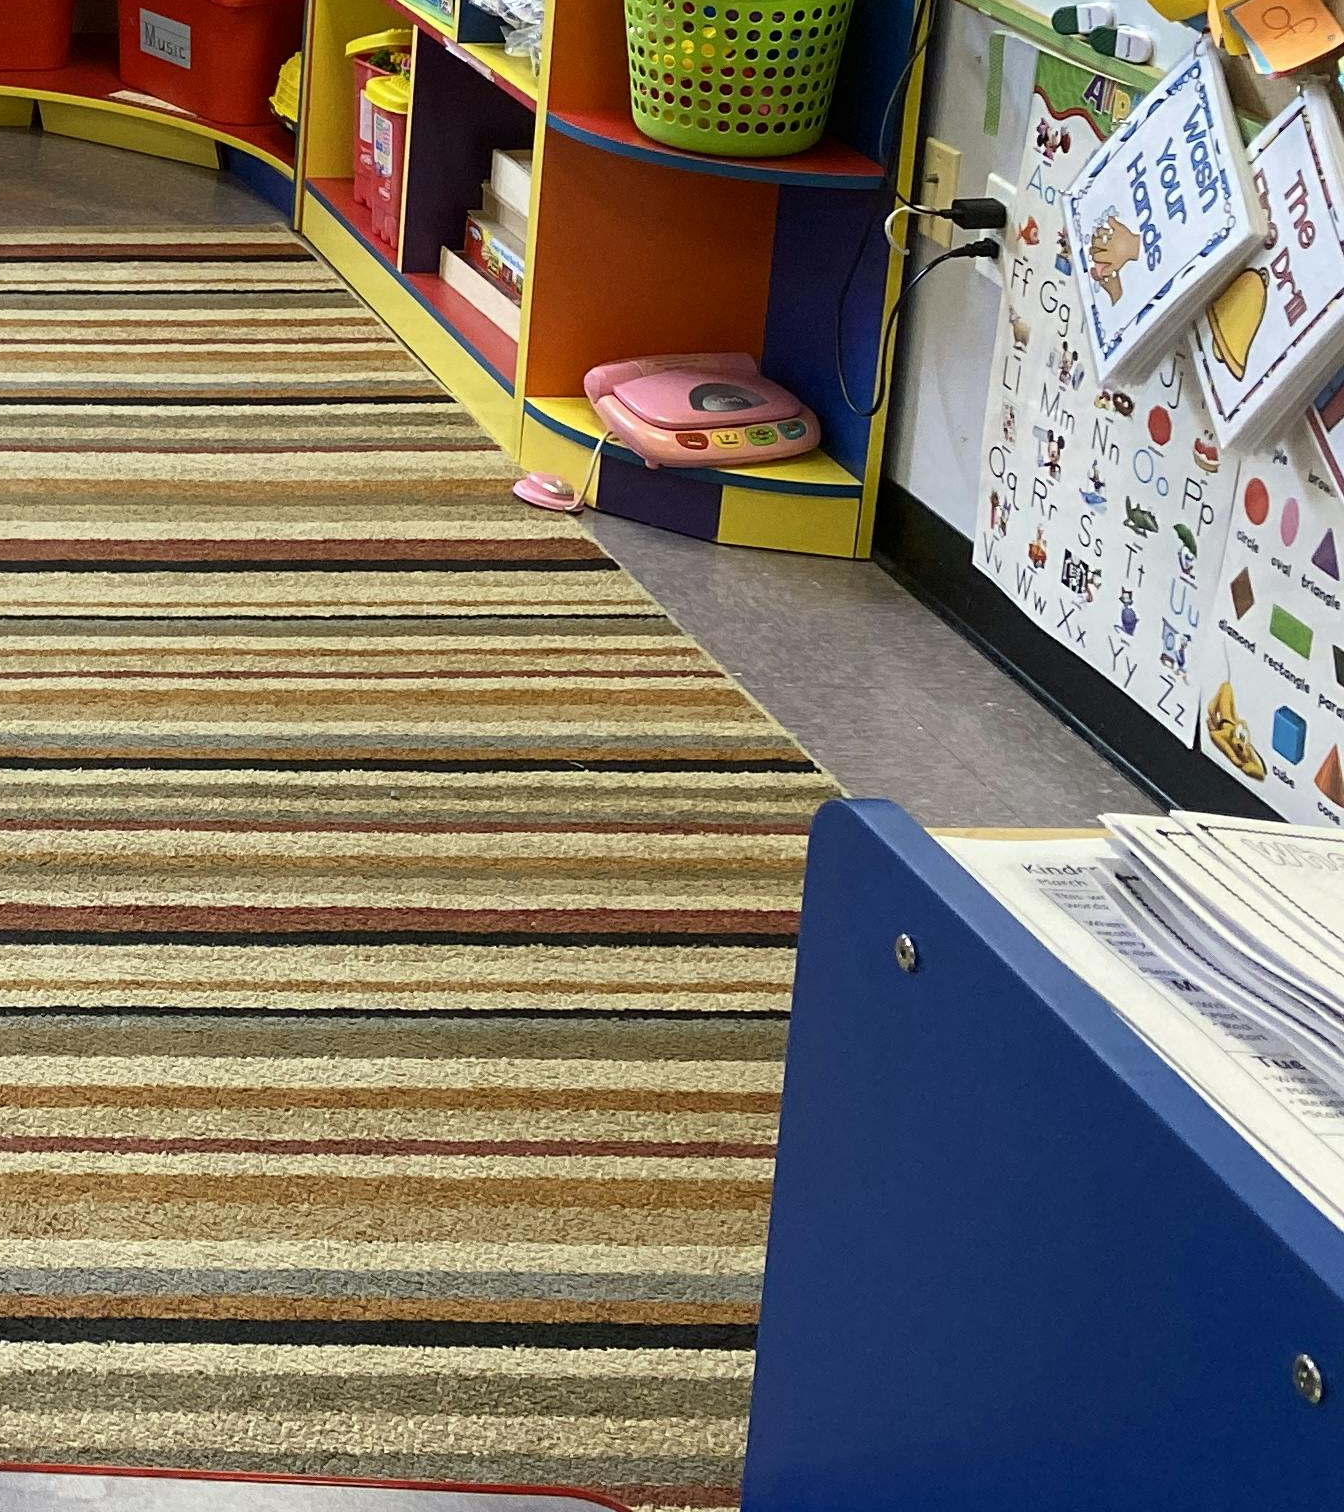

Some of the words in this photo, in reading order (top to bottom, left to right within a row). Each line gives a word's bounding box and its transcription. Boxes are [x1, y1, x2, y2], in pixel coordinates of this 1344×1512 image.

[143, 21, 186, 60] Music
[1027, 165, 1056, 206] Aa
[1156, 138, 1188, 225] Your
[1183, 103, 1220, 214] Wash
[1126, 152, 1163, 272] Hands
[1284, 169, 1317, 250] The
[1011, 259, 1035, 297] Ff
[1039, 280, 1071, 337] Gg
[1269, 247, 1309, 327] Drill
[1159, 358, 1185, 410] Jj
[1003, 360, 1022, 395] Ll
[1041, 382, 1075, 433] Mm
[1091, 418, 1120, 466] Nn
[1132, 448, 1170, 497] Oo
[1182, 477, 1215, 537] Pp
[989, 445, 1020, 512] Qq
[1031, 477, 1058, 522] Rr
[1077, 514, 1104, 558] Ss
[1124, 543, 1146, 588] Tt
[1169, 578, 1200, 629] Uu
[1236, 528, 1260, 555] circle
[1270, 555, 1292, 578] oval
[1300, 573, 1342, 611] triangle
[983, 531, 1003, 574] Vv
[1016, 569, 1047, 616] Ww
[1056, 598, 1088, 649] Xx
[1106, 635, 1138, 689] Yy
[1155, 674, 1186, 728] Zz
[1217, 618, 1257, 655] diamond
[1263, 652, 1311, 695] rectangle
[1271, 764, 1296, 789] cube
[1317, 799, 1342, 826] cone
